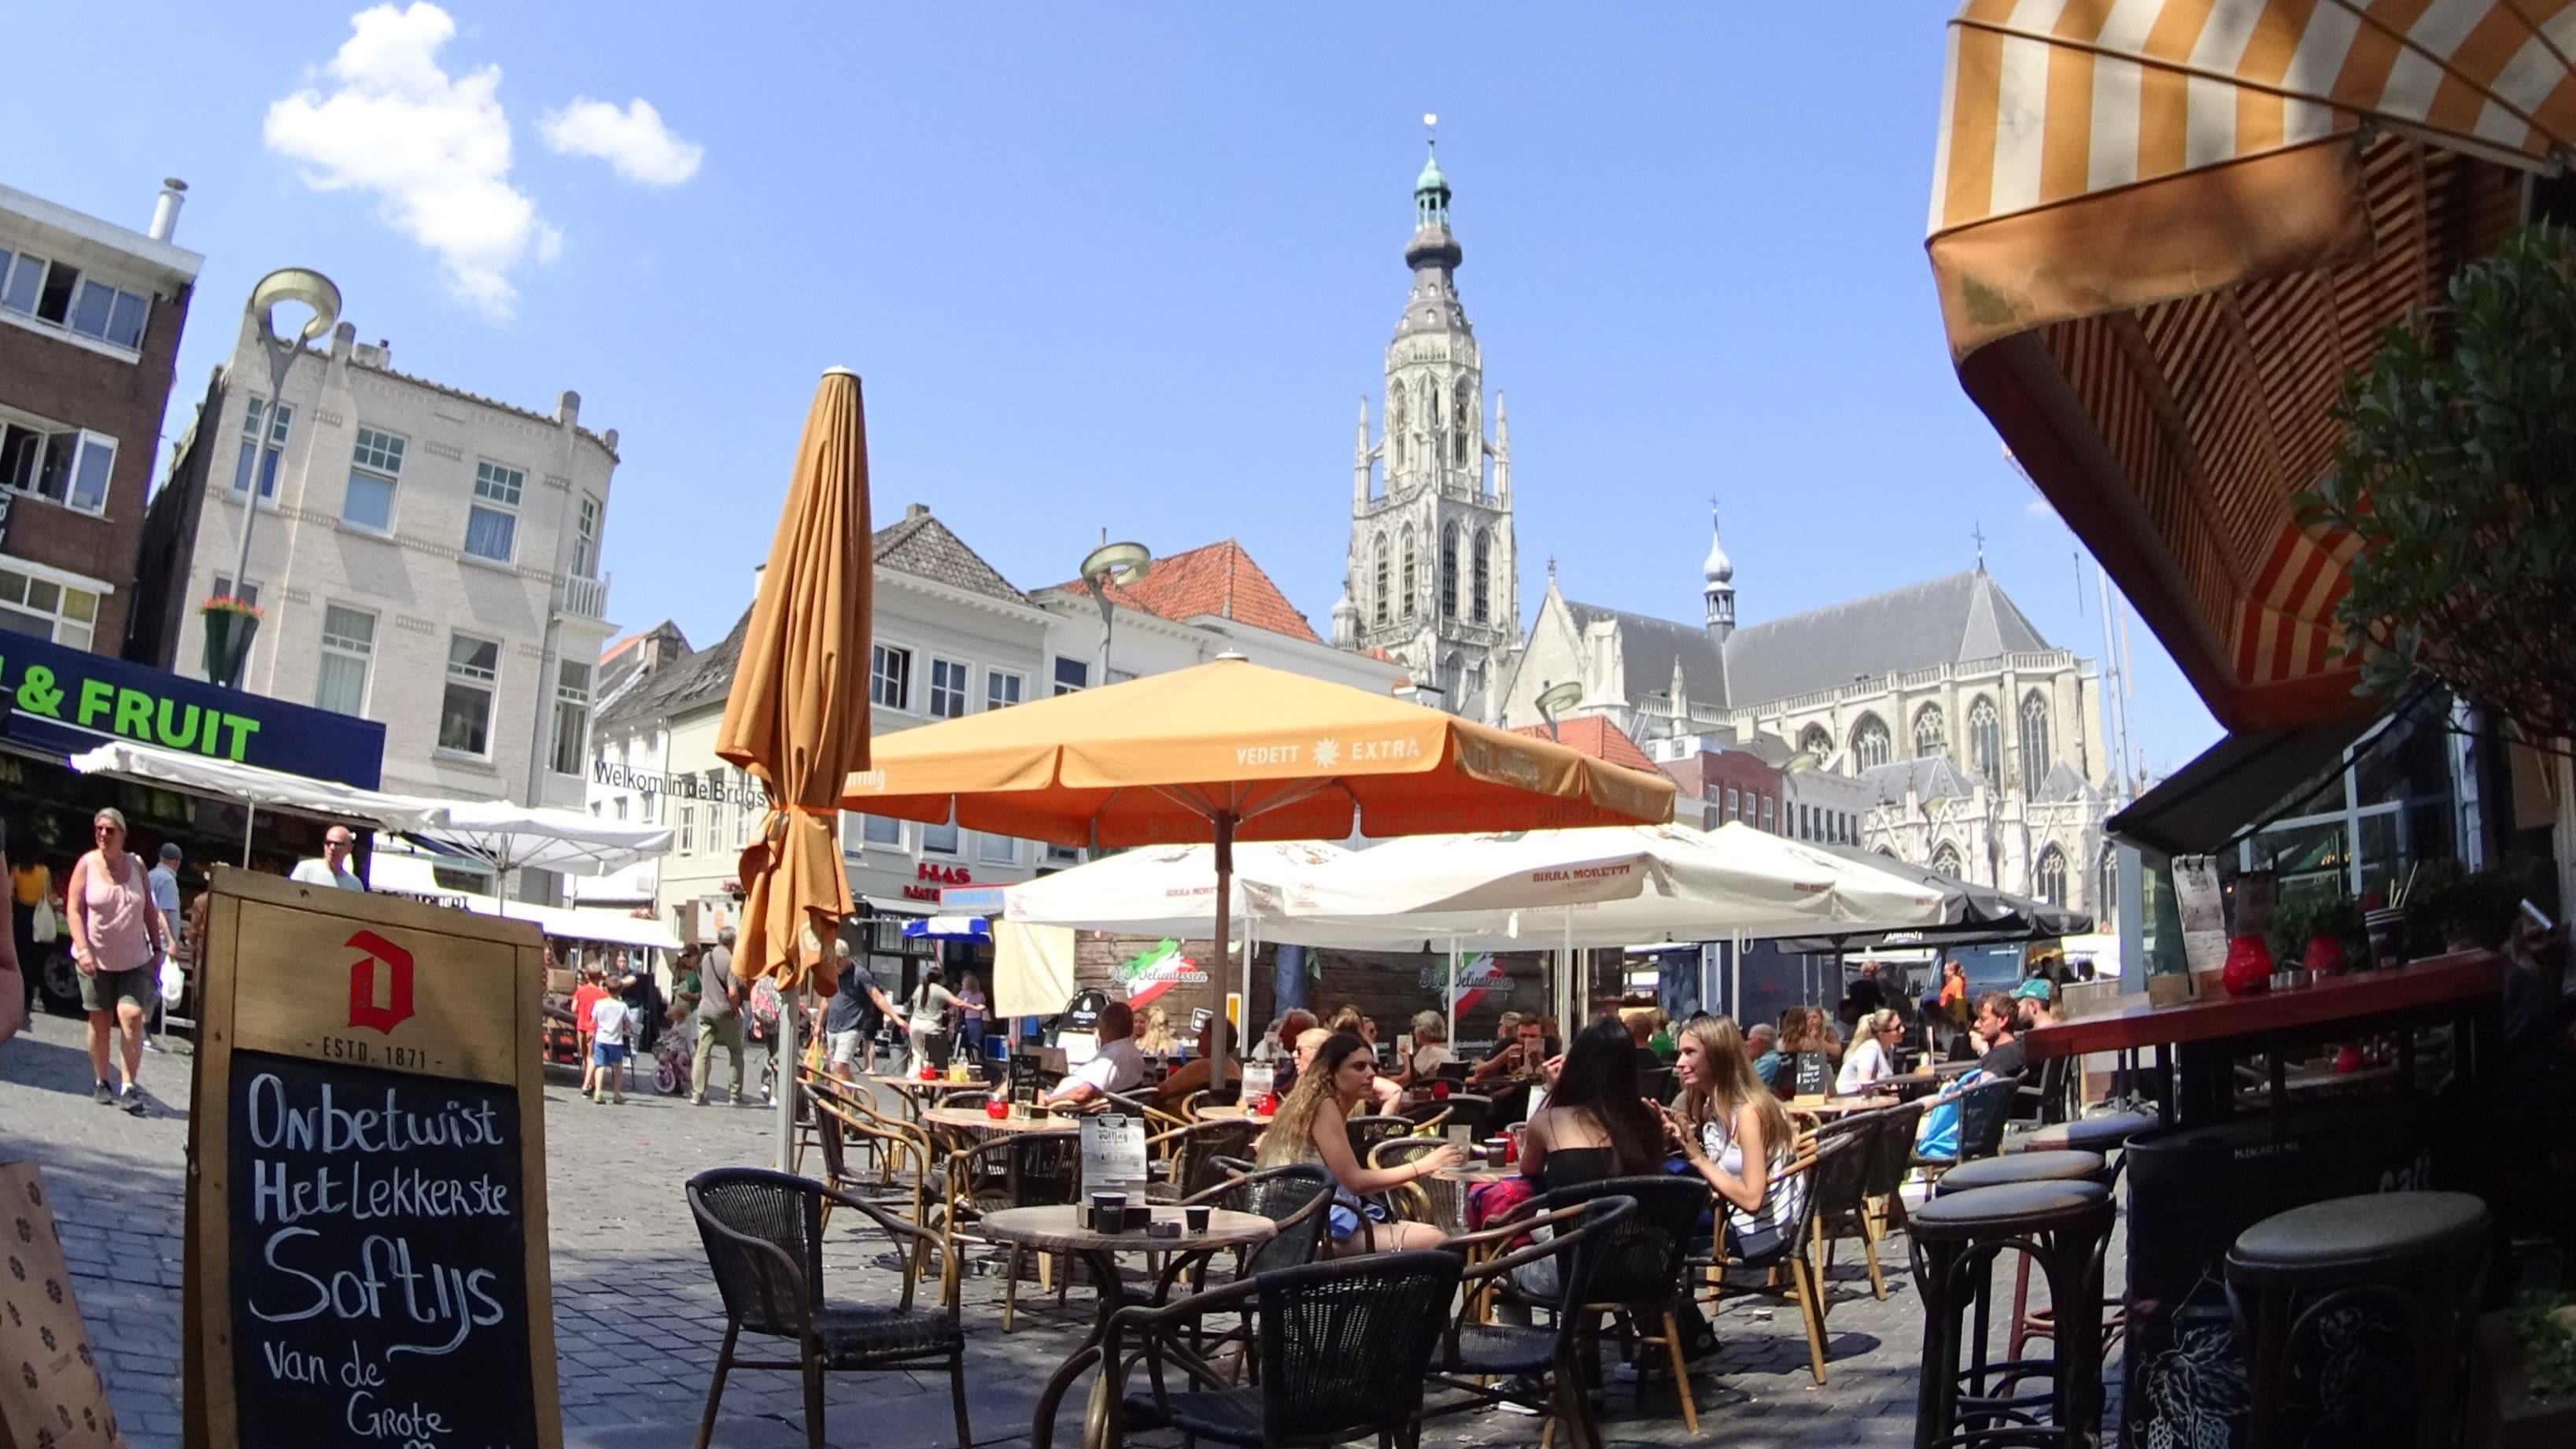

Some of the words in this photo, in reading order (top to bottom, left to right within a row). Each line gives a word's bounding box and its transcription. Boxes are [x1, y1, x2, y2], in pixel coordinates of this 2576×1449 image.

[17, 665, 65, 718] &
[77, 678, 260, 762] FRUIT
[1236, 745, 1300, 766] VEDETT
[1351, 737, 1421, 760] EXTRA
[595, 760, 663, 794] Welkom
[917, 863, 972, 884] HAS
[1533, 870, 1570, 882] BIRRA
[1573, 864, 1630, 879] MORETTI
[1138, 967, 1209, 983] Delicatessen
[386, 1045, 426, 1070] 1871
[254, 1159, 348, 1225] Het
[340, 1340, 385, 1388] de
